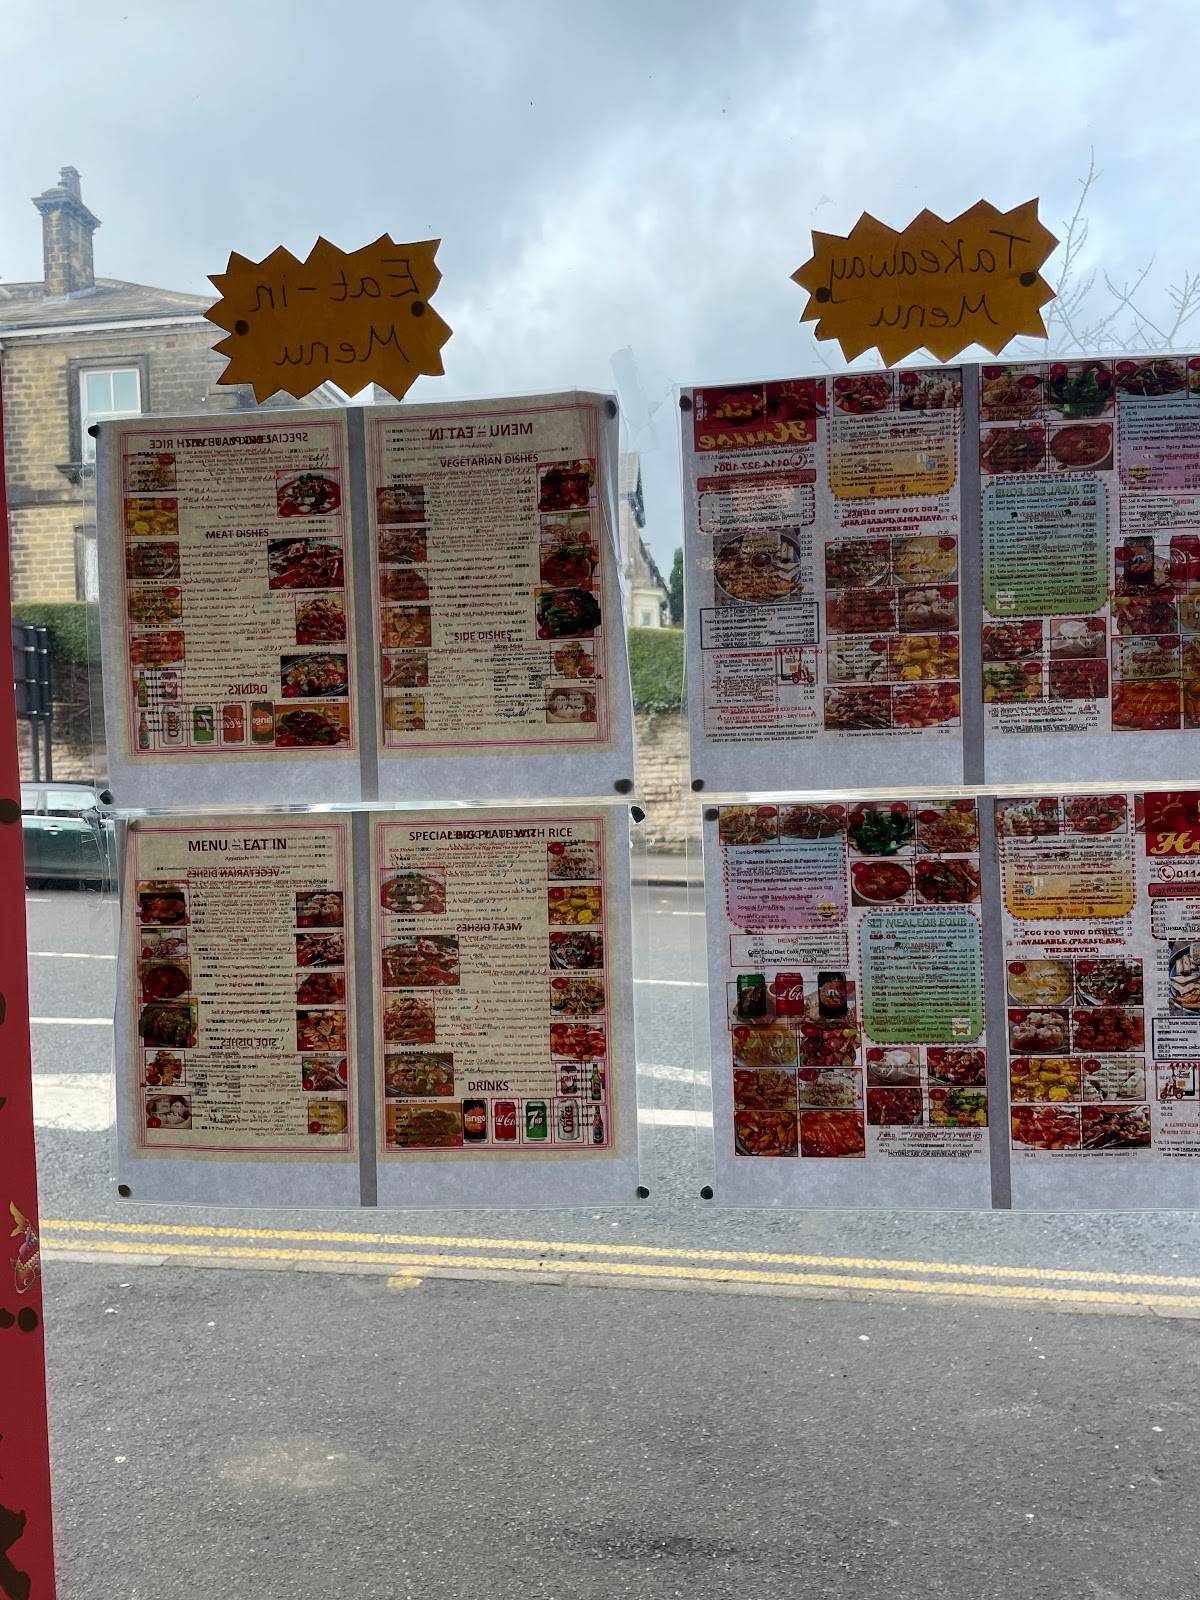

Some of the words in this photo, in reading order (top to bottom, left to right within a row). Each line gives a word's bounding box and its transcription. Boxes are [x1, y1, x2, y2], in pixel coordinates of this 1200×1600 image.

[440, 457, 502, 469] VEGETARIAN
[505, 454, 539, 464] DISHES
[206, 531, 233, 540] MEAT
[236, 529, 270, 538] DISHES
[455, 632, 476, 642] SIDE
[479, 630, 512, 641] DISHES
[549, 828, 573, 838] RICE
[188, 840, 228, 852] MENU
[244, 839, 270, 851] EAT
[273, 839, 288, 850] IN
[887, 919, 912, 928] MEAL
[917, 918, 937, 927] FOR
[939, 917, 968, 927] FOUR
[468, 1081, 509, 1092] DRINKS
